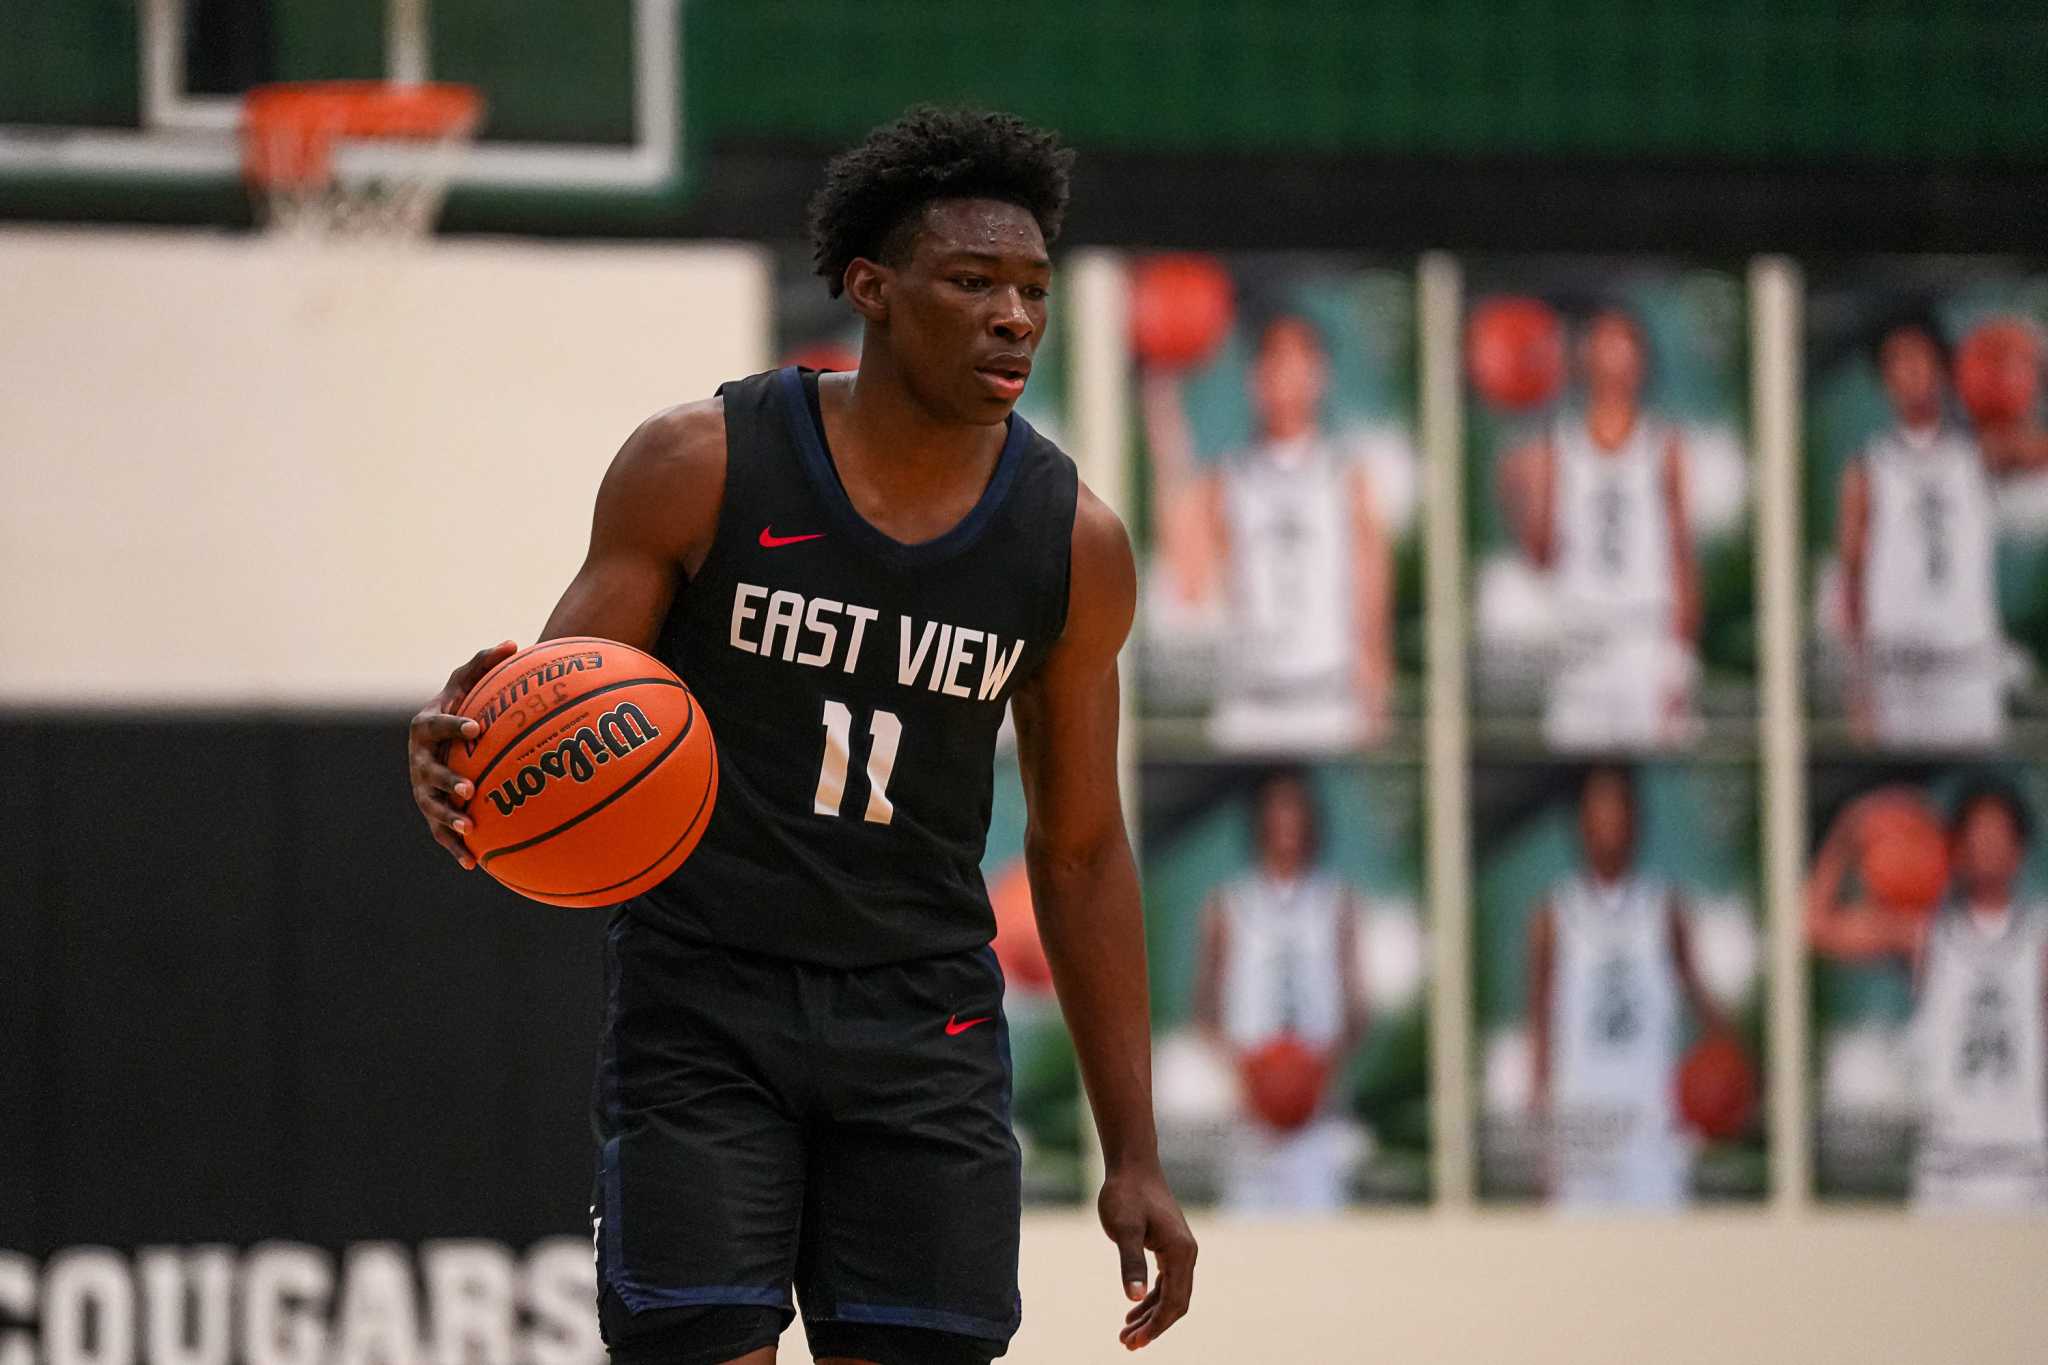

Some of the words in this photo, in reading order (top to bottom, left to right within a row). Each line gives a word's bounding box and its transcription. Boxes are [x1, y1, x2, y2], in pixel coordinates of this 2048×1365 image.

[730, 582, 879, 674] EAST
[898, 615, 1025, 701] VIEW
[489, 702, 661, 816] Wilson
[814, 700, 902, 825] 11
